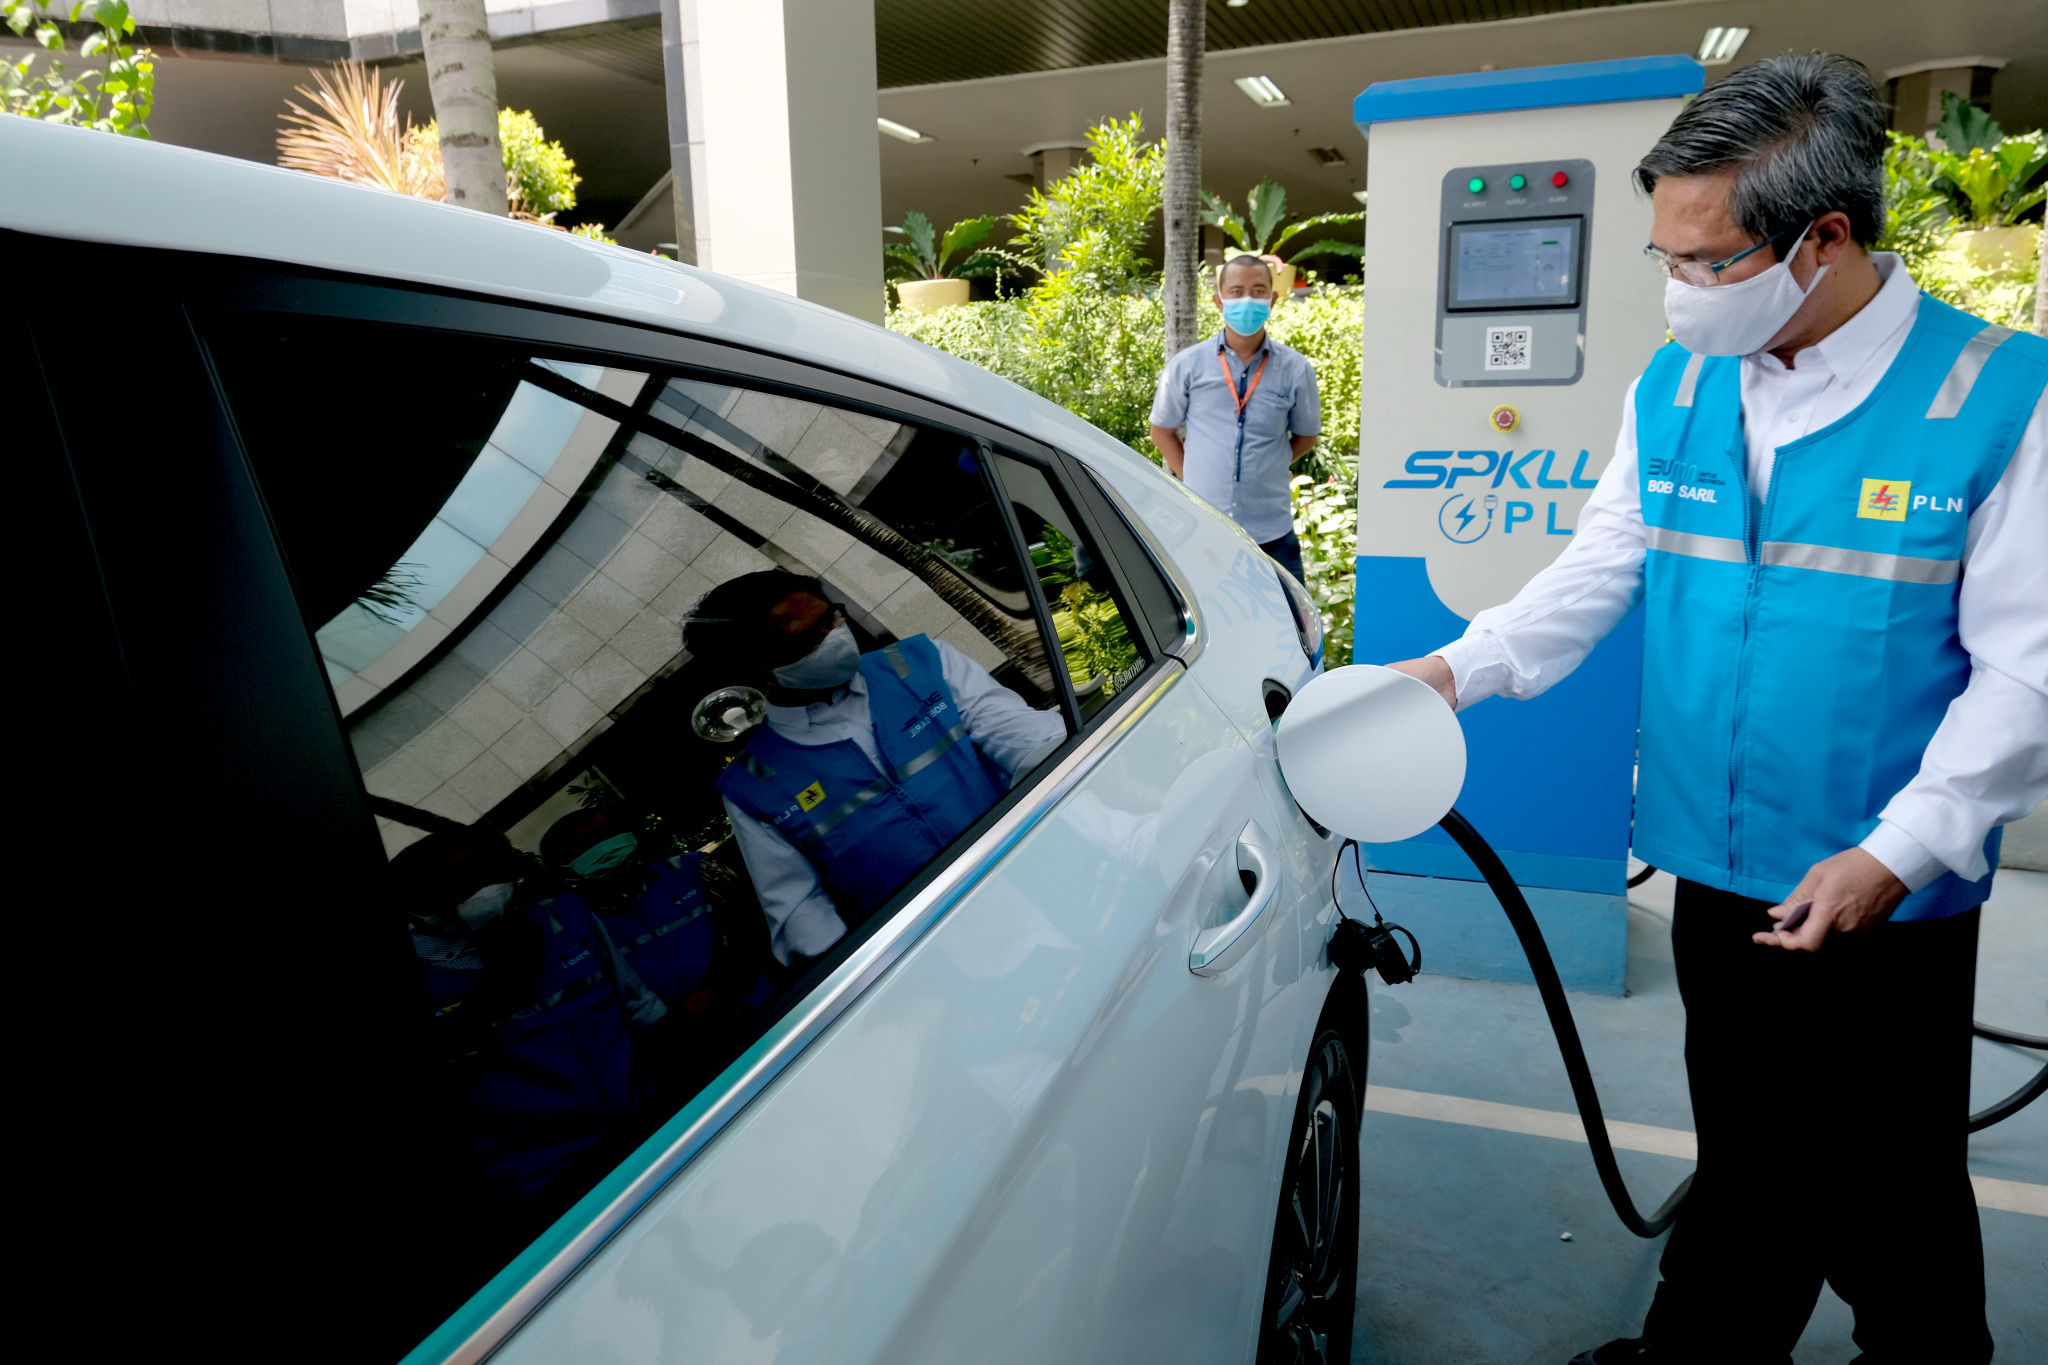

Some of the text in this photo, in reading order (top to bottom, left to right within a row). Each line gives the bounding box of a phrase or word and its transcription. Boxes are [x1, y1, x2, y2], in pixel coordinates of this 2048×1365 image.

[1647, 479, 1717, 503] BOB SARIL
[1913, 495, 1963, 513] PLN
[1504, 501, 1574, 535] PL
